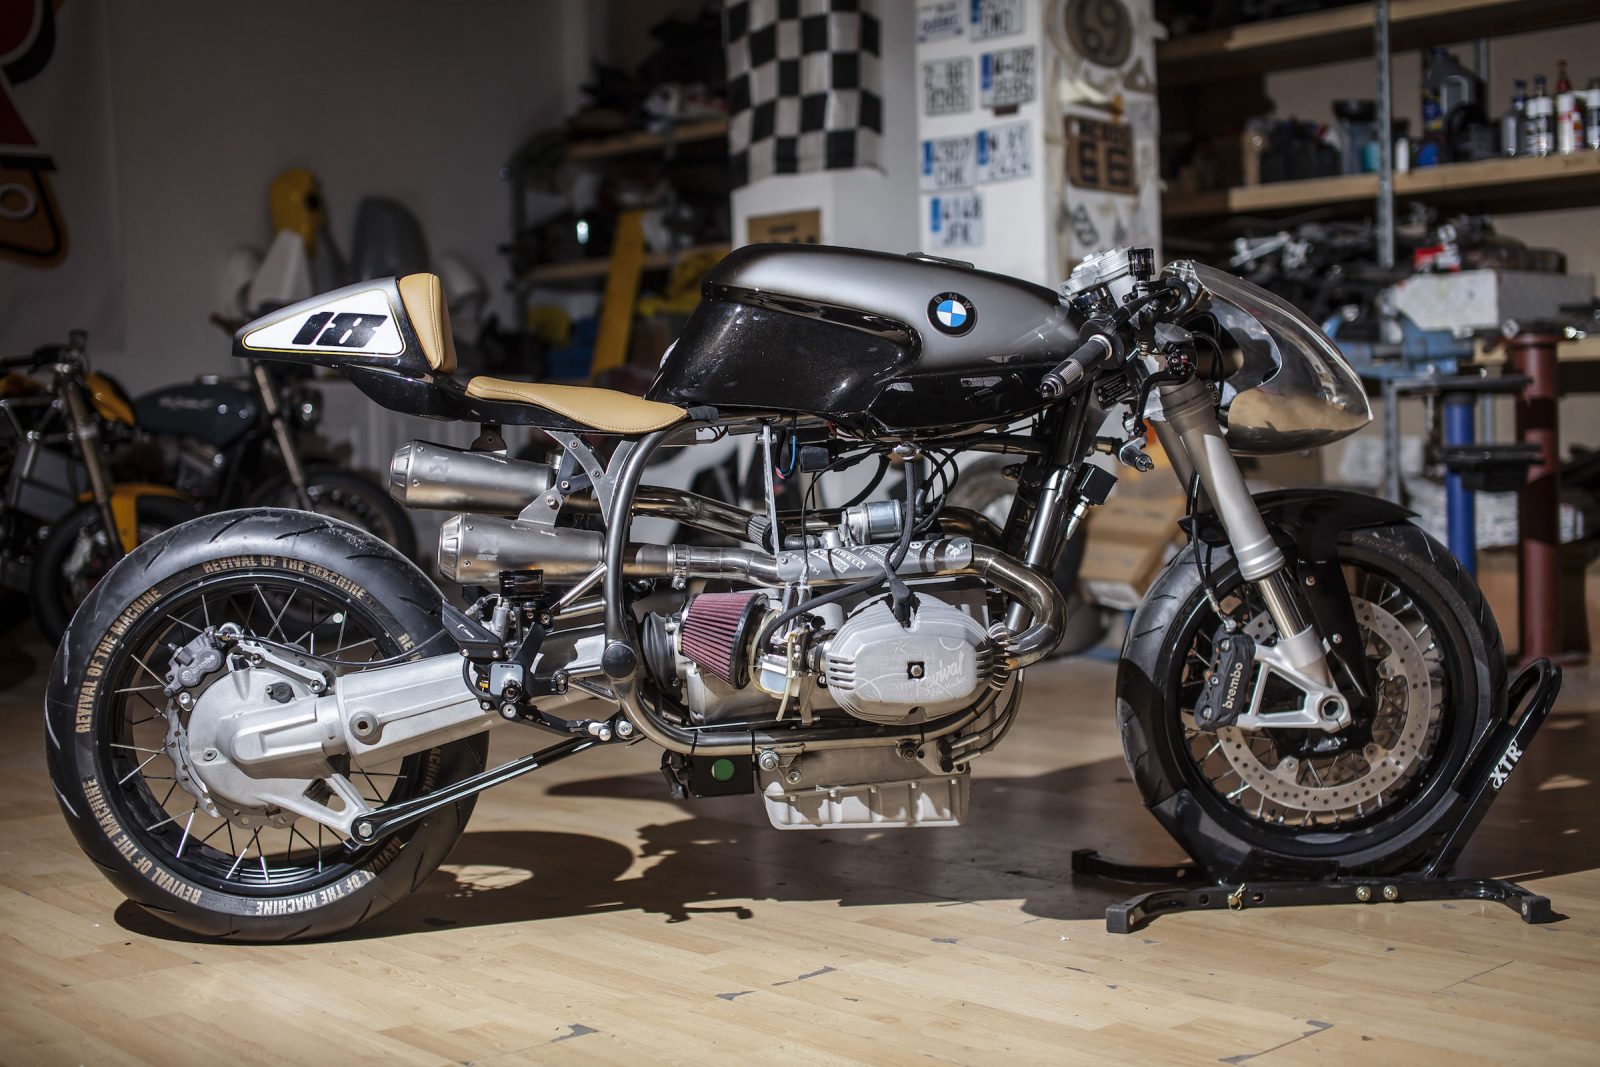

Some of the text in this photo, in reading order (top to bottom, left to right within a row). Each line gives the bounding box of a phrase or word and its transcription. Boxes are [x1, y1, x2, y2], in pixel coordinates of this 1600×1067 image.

[934, 293, 973, 309] BMW
[292, 311, 388, 348] 18
[202, 555, 258, 574] REVIVAL
[261, 556, 277, 567] OF
[282, 557, 306, 573] THE
[785, 552, 821, 575] ZENTH
[75, 586, 162, 734] REVIVAL OF THE MACHINE
[1222, 662, 1244, 710] brembo
[82, 778, 203, 905] REVIVAL OF THE MACHINE
[320, 882, 345, 902] THE
[346, 875, 362, 890] OF
[255, 893, 317, 916] MACHINE
